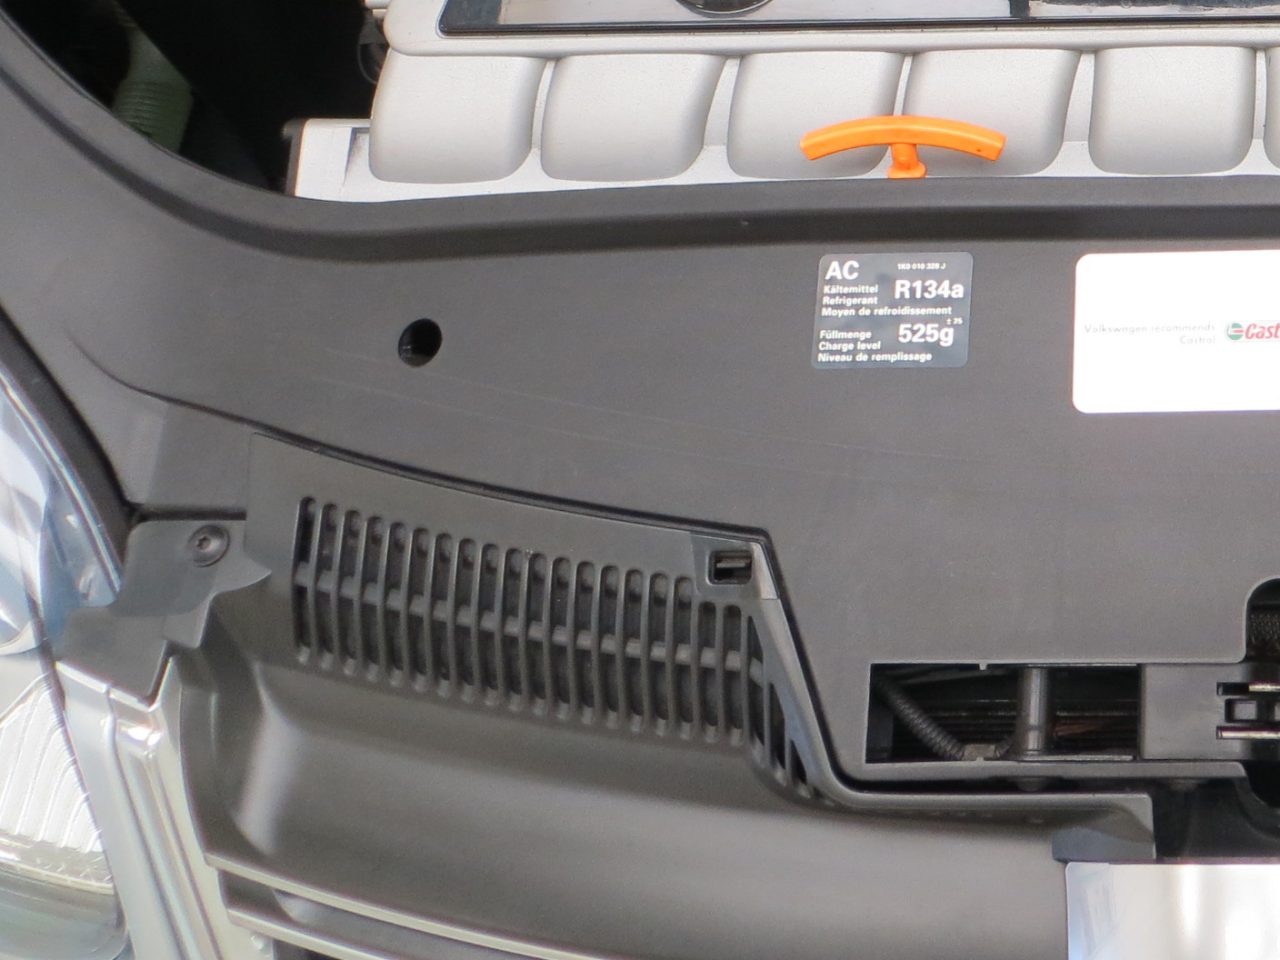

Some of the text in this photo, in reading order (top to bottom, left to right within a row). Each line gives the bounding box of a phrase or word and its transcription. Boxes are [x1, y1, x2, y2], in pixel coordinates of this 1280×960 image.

[825, 260, 859, 280] AC
[823, 285, 878, 294] Kältemittel
[895, 280, 964, 299] R134a
[823, 296, 878, 306] Refrigerant
[822, 306, 952, 317] Moyen de refroidissement
[820, 330, 872, 340] Füllmenge
[898, 323, 954, 347] 525g
[819, 341, 881, 352] Charge level
[818, 352, 932, 363] Niveau de remplissage
